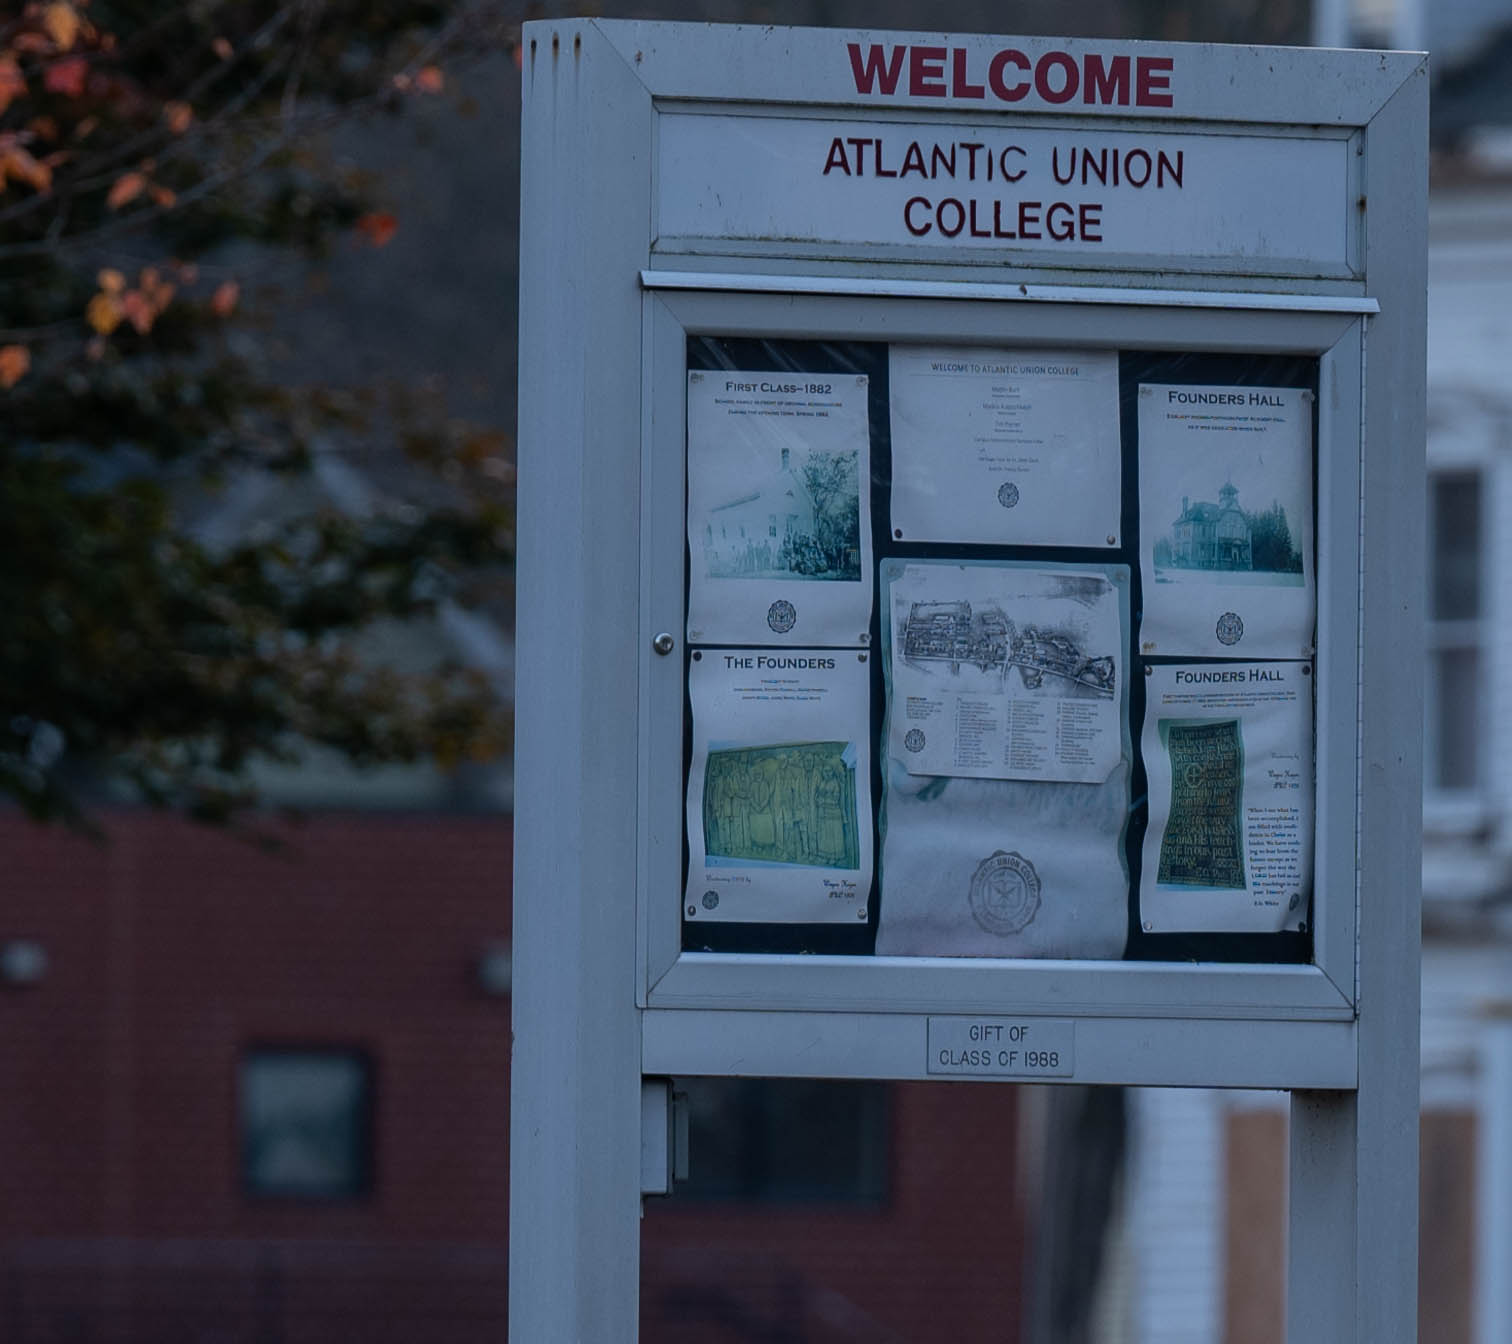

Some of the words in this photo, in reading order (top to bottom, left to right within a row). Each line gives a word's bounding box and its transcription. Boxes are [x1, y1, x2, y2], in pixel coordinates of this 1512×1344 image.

[847, 42, 1175, 109] WELCOME
[822, 137, 1028, 183] ATLANTIC
[1052, 146, 1184, 190] UNION
[903, 197, 1104, 244] COLLEGE
[931, 363, 969, 373] WELCOME
[970, 365, 981, 373] TO
[982, 365, 1018, 374] ATLANTIC
[1021, 366, 1046, 375] UNION
[1047, 366, 1080, 376] COLLEGE
[725, 381, 758, 393] FIRST
[1168, 390, 1245, 405] FOUNDERS
[1248, 392, 1285, 407] HALL
[724, 656, 753, 669] THE
[757, 656, 836, 669] FOUNDERS
[1175, 670, 1246, 684] FOUNDERS
[1249, 668, 1285, 682] HALL
[969, 1025, 1004, 1041] GIFT
[1009, 1026, 1029, 1042] OF
[939, 1049, 992, 1066] CLASS
[998, 1050, 1019, 1067] OF
[1024, 1051, 1059, 1067] 1988
